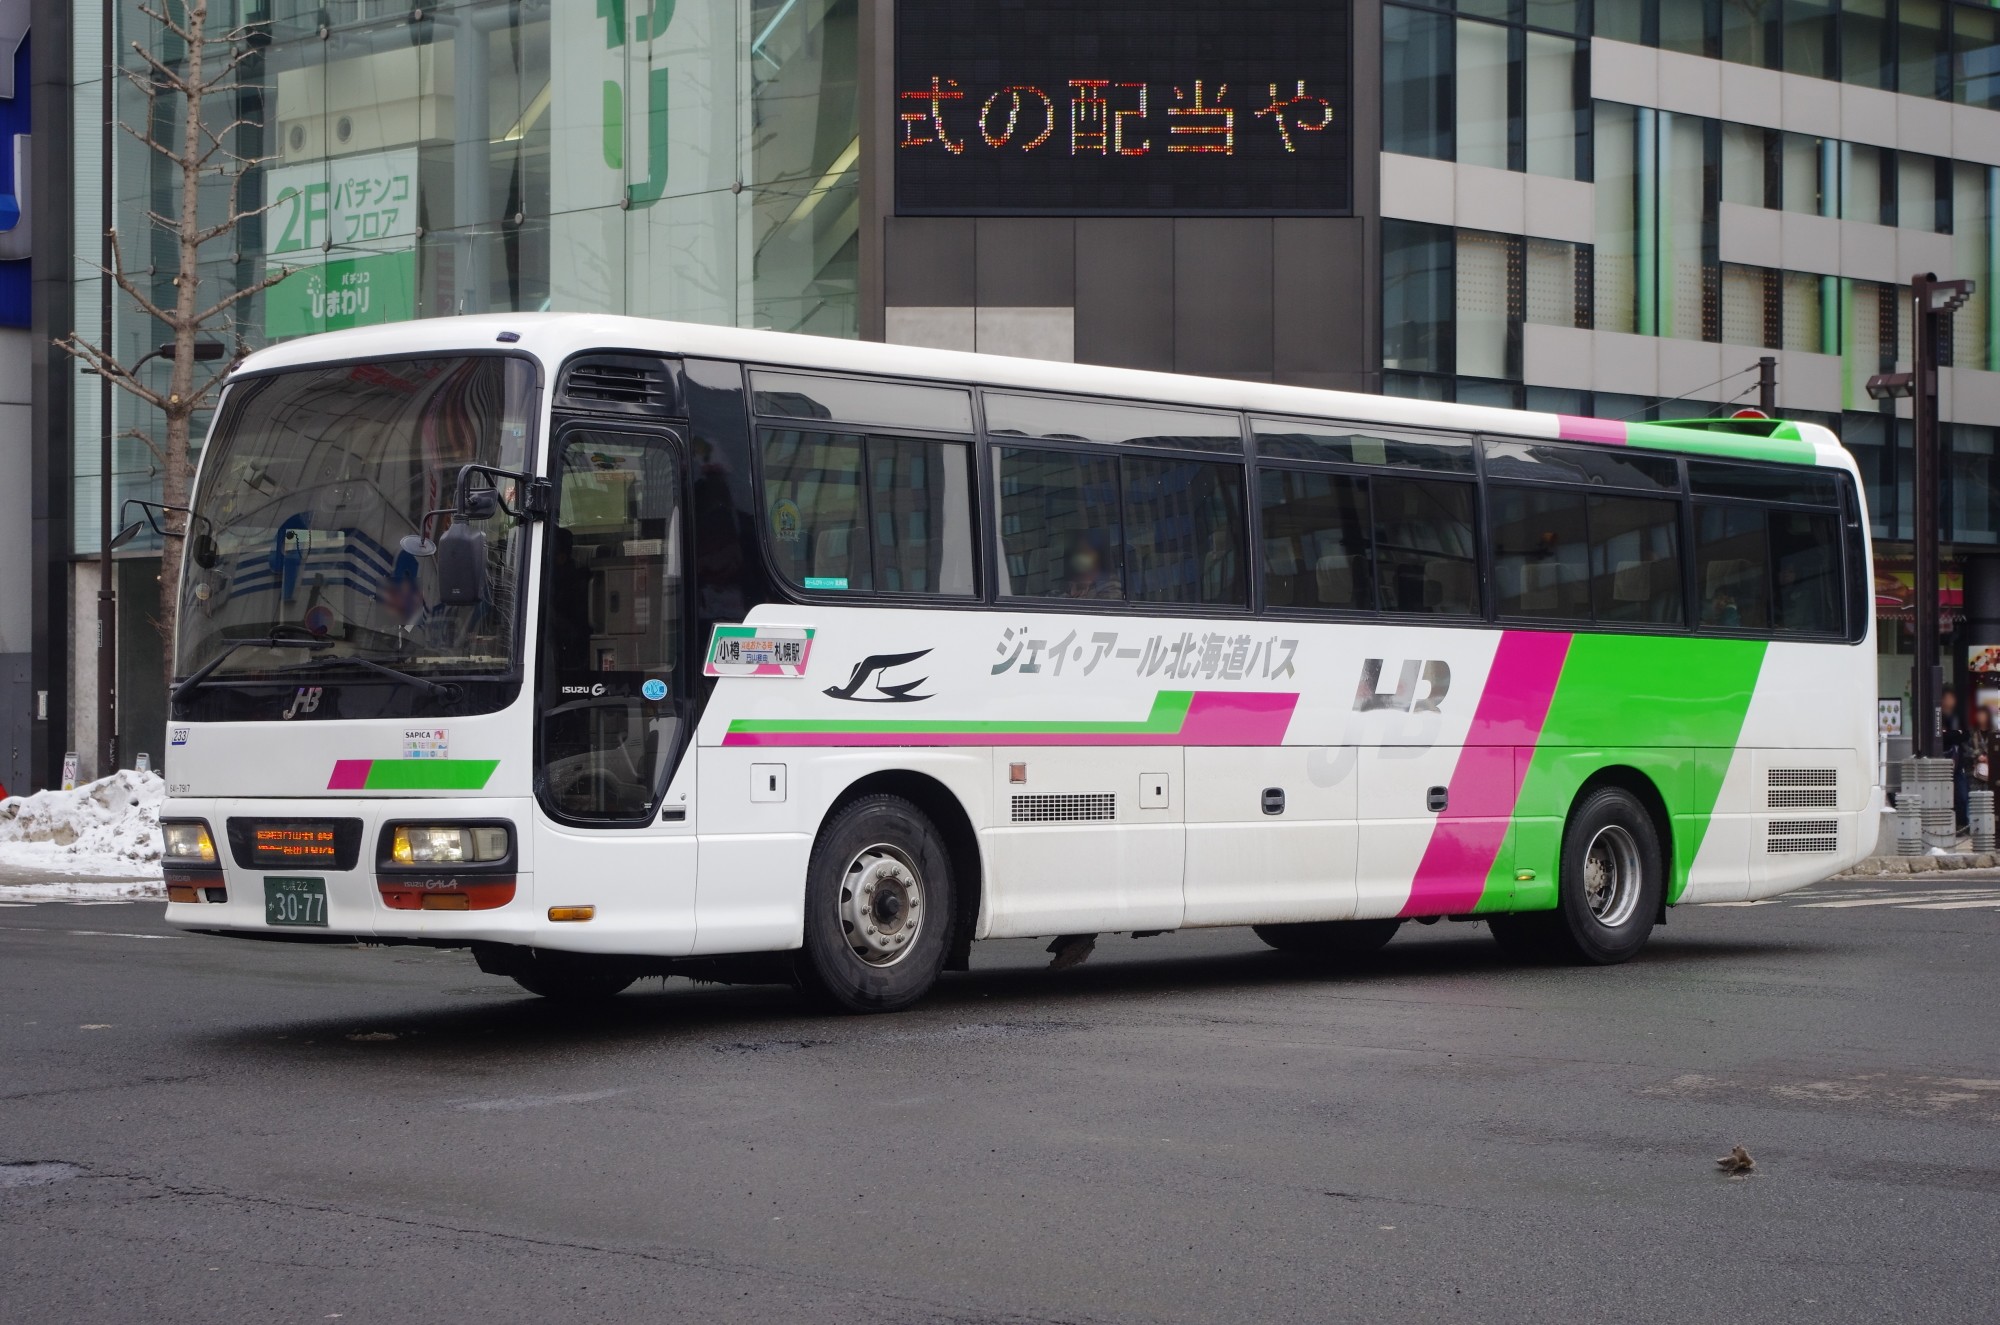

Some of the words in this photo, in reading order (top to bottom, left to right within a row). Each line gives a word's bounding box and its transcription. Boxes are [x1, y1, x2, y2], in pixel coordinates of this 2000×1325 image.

[901, 76, 1333, 155] 式の配当や
[334, 175, 409, 211] パチンコ
[274, 182, 330, 254] 2F
[344, 208, 399, 242] フロア
[341, 271, 370, 285] パチンコ
[307, 284, 370, 319] ひまわり
[719, 640, 740, 660] 小樽
[774, 641, 800, 662] 札幌駅
[562, 686, 590, 694] ISUZU
[173, 730, 187, 742] 233
[405, 731, 431, 739] SAPICA
[425, 879, 458, 890] GALA
[275, 892, 324, 922] 30-77
